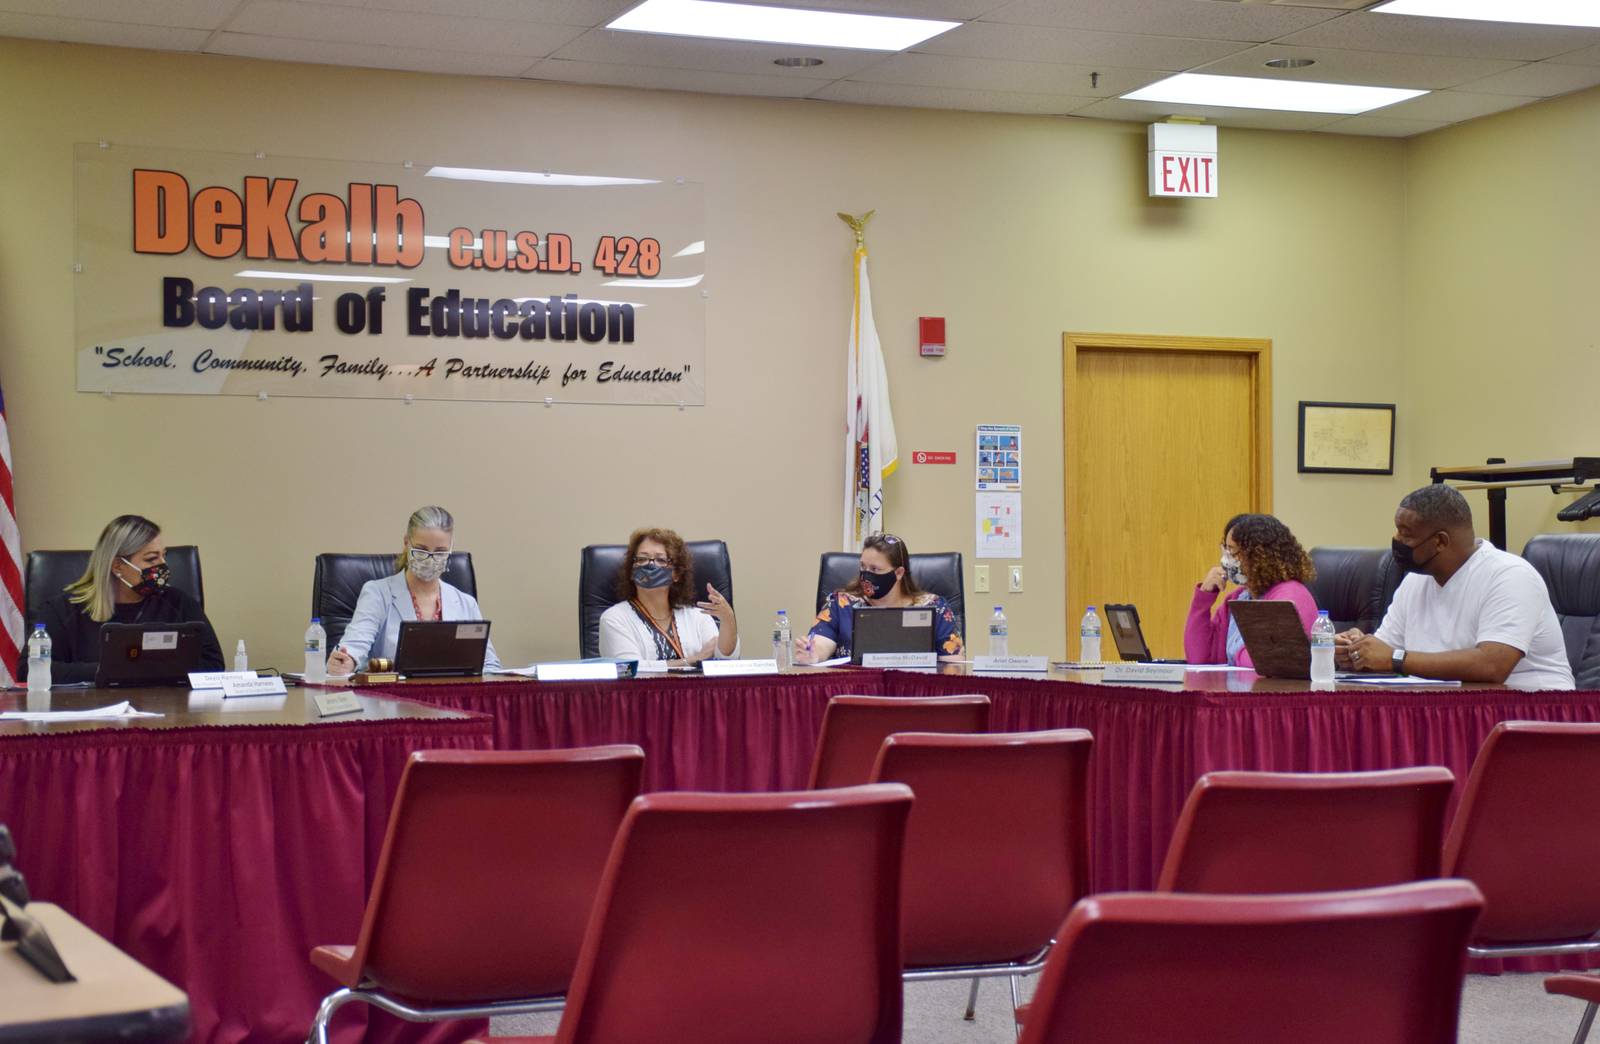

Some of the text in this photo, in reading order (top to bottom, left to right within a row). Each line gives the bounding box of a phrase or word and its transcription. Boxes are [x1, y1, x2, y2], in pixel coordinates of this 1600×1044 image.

[1162, 156, 1213, 193] EXIT
[133, 168, 425, 269] DeKalb
[448, 226, 661, 278] C.U.S.D. 428
[163, 276, 635, 344] Board of Education
[445, 358, 551, 385] Partnership
[562, 363, 588, 388] for
